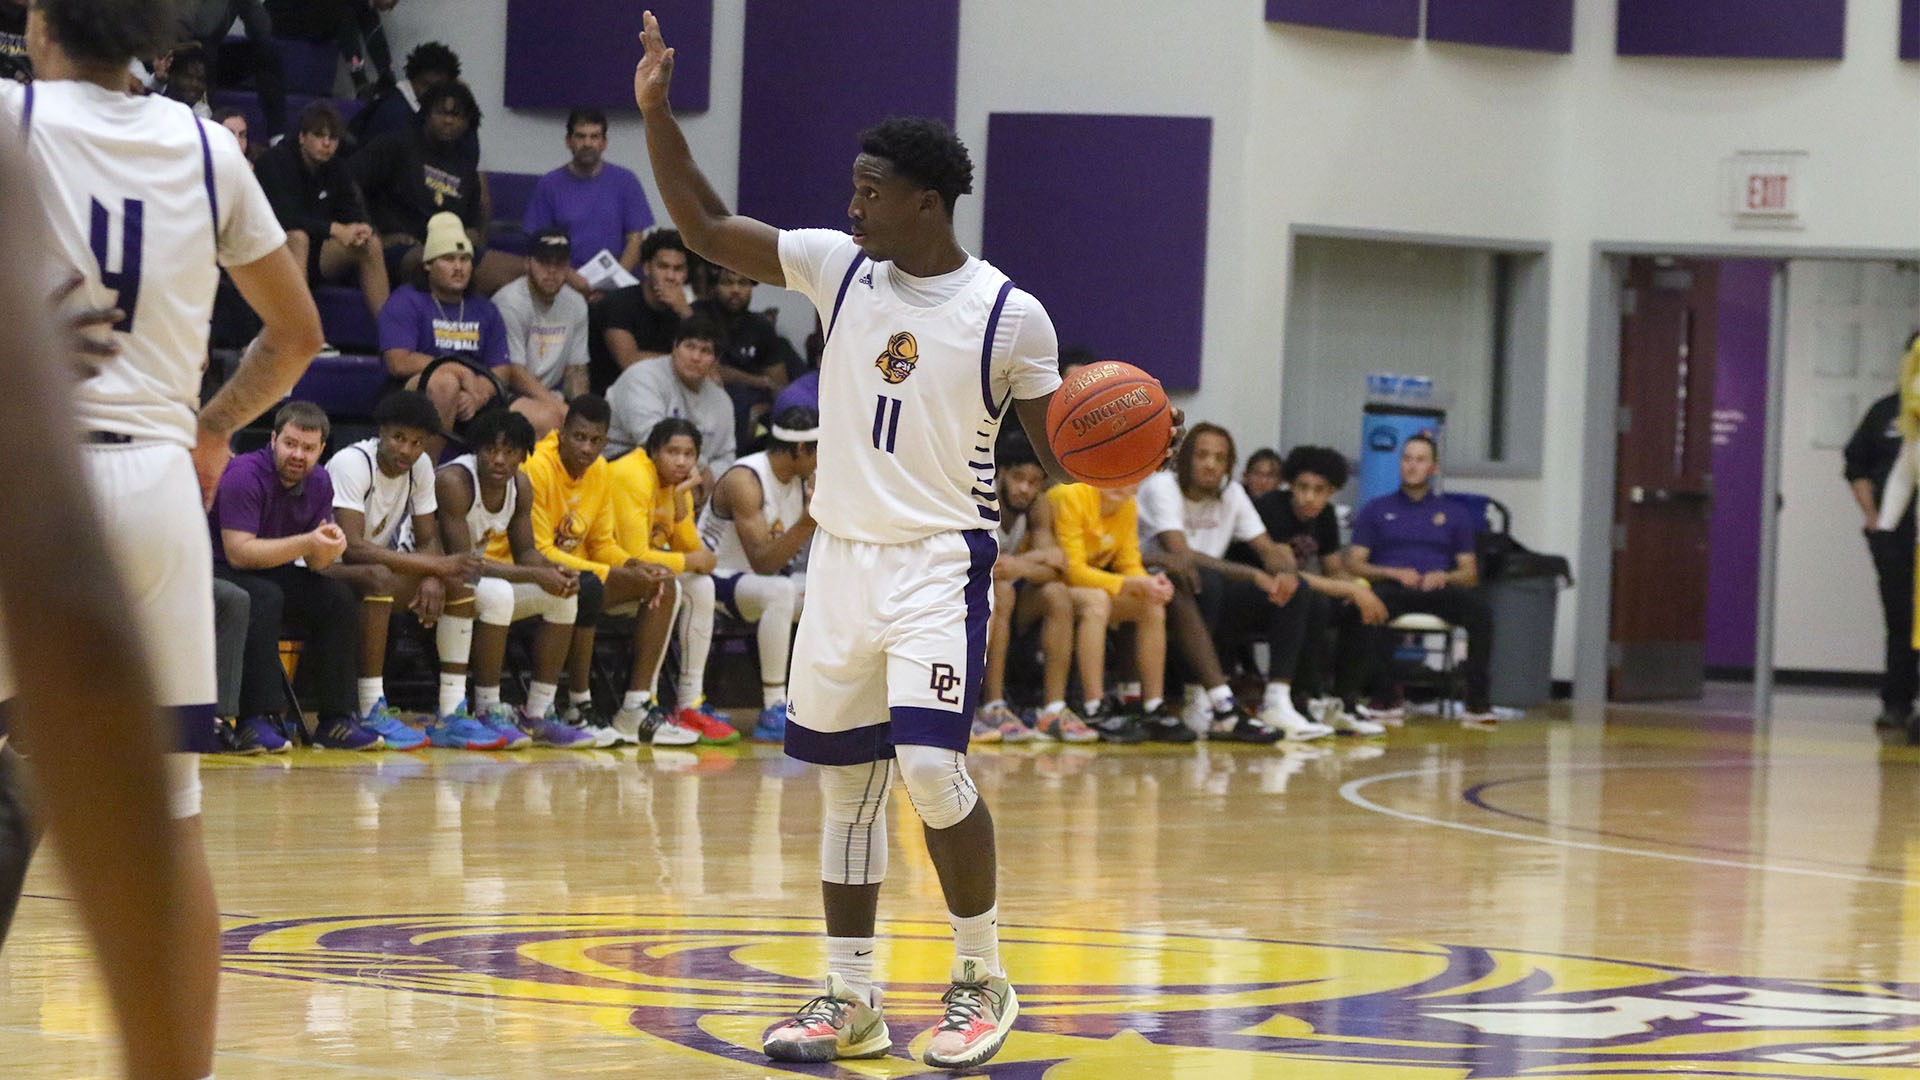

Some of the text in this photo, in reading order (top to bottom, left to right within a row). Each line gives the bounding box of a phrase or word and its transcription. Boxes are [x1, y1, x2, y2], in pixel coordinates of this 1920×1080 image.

[1747, 175, 1788, 209] EXIT
[89, 195, 144, 334] 4
[872, 394, 903, 454] 11
[1070, 384, 1153, 438] SPALDING
[930, 663, 961, 705] DC
